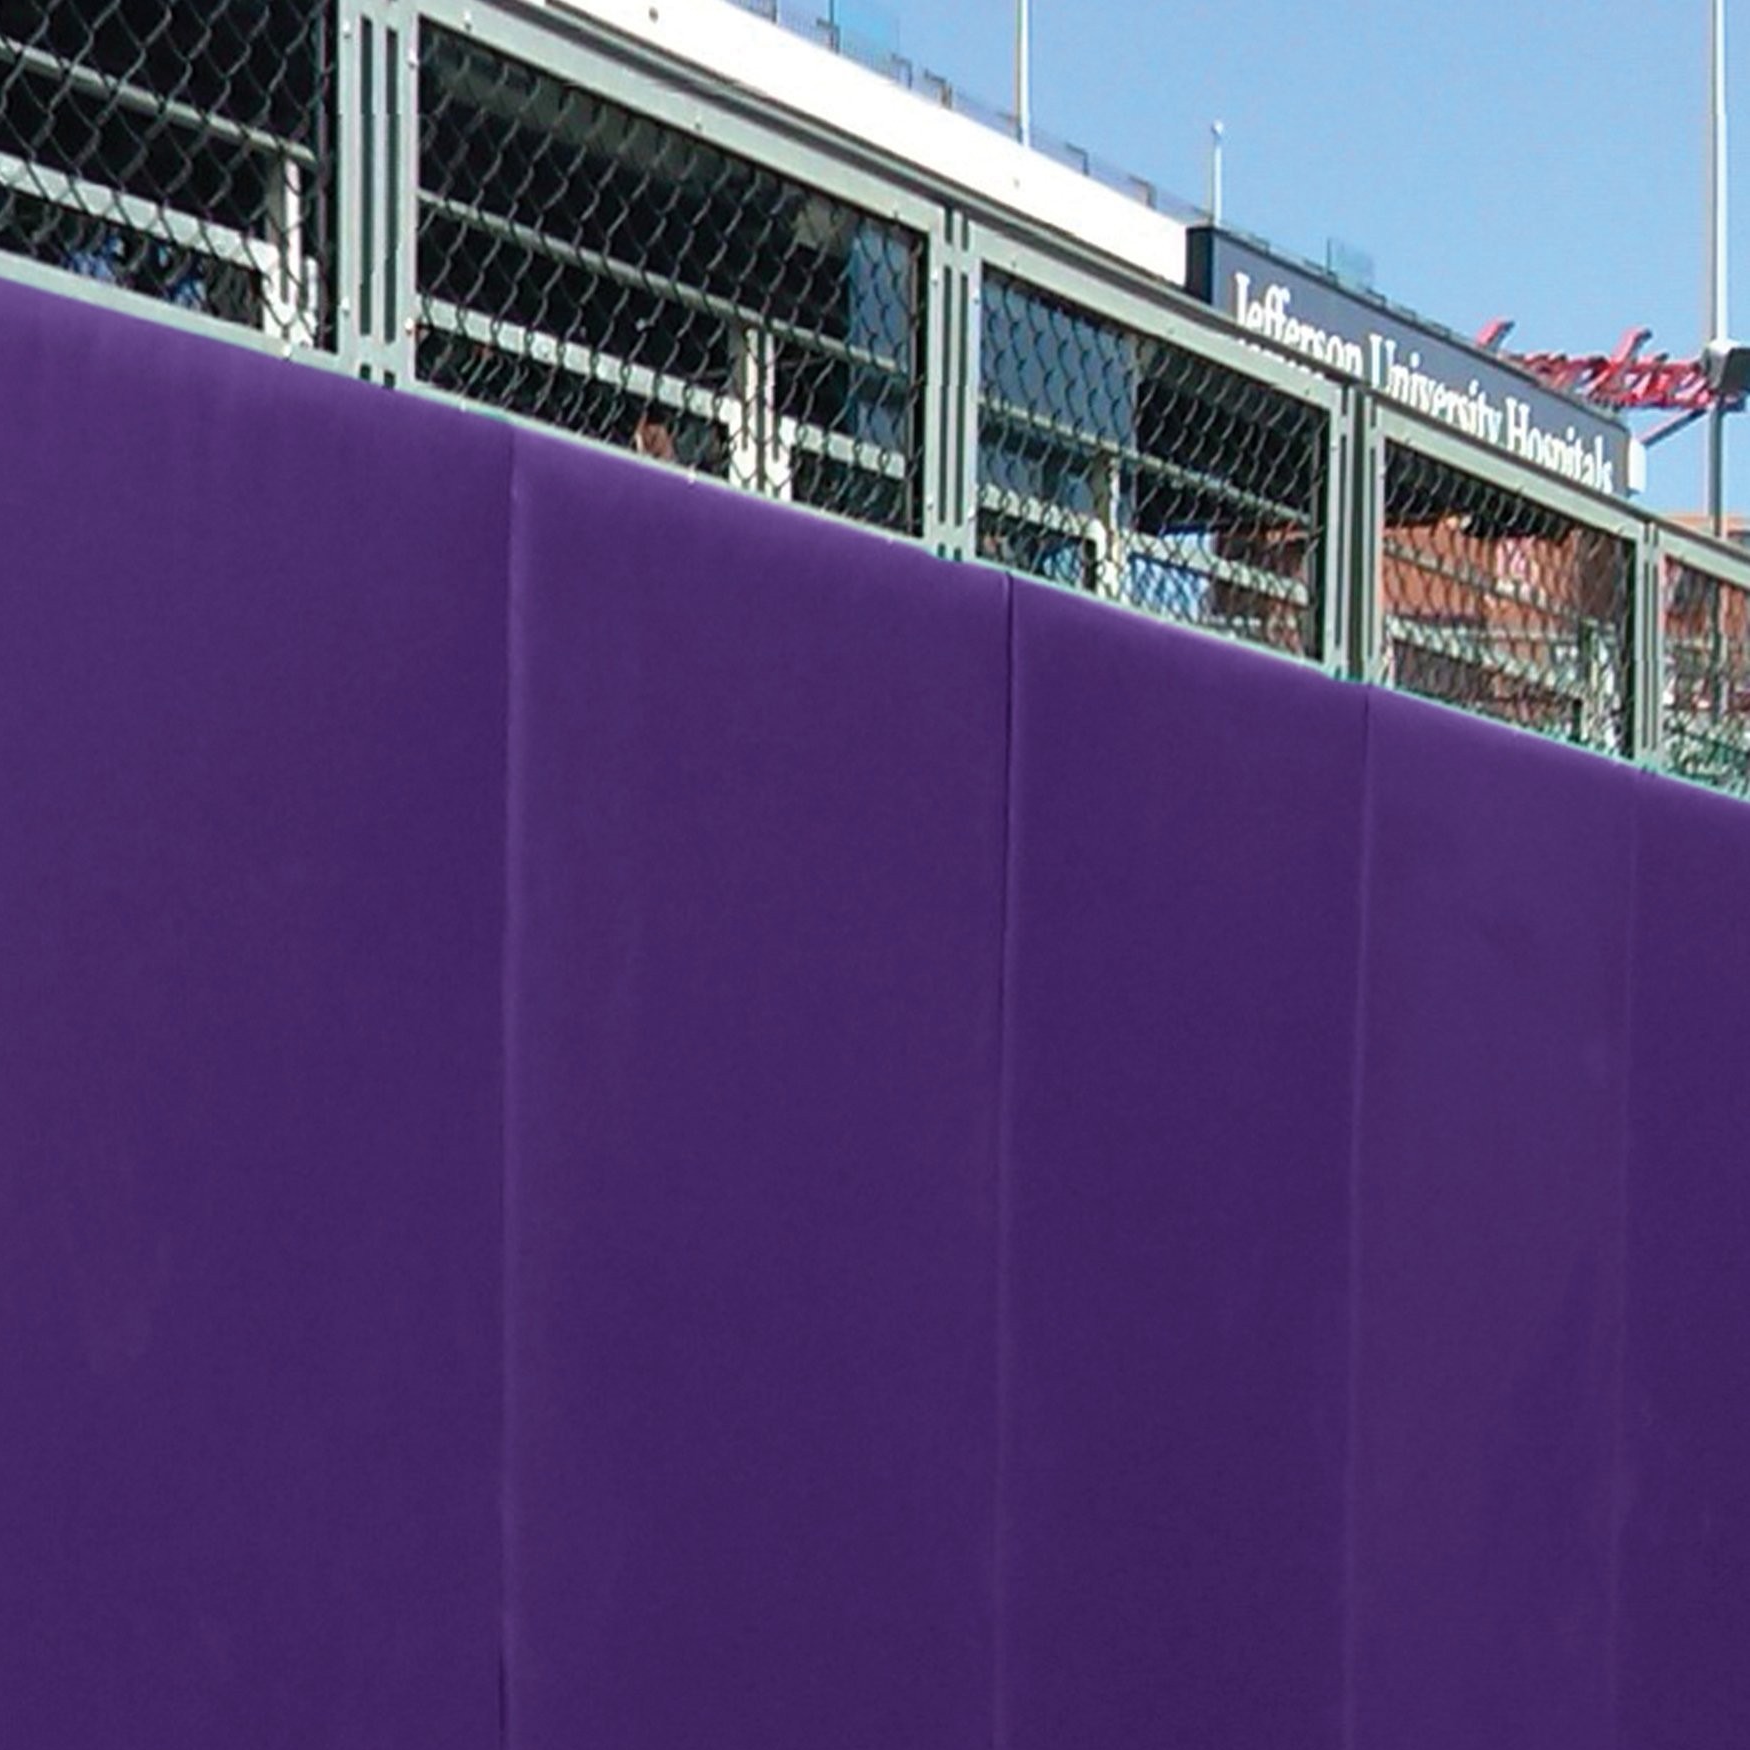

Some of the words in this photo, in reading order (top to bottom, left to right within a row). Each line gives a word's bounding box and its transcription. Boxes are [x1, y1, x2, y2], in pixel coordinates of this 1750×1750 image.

[1235, 271, 1363, 378] Jefferson
[1369, 333, 1502, 444] University
[1505, 397, 1613, 495] Hospitals
